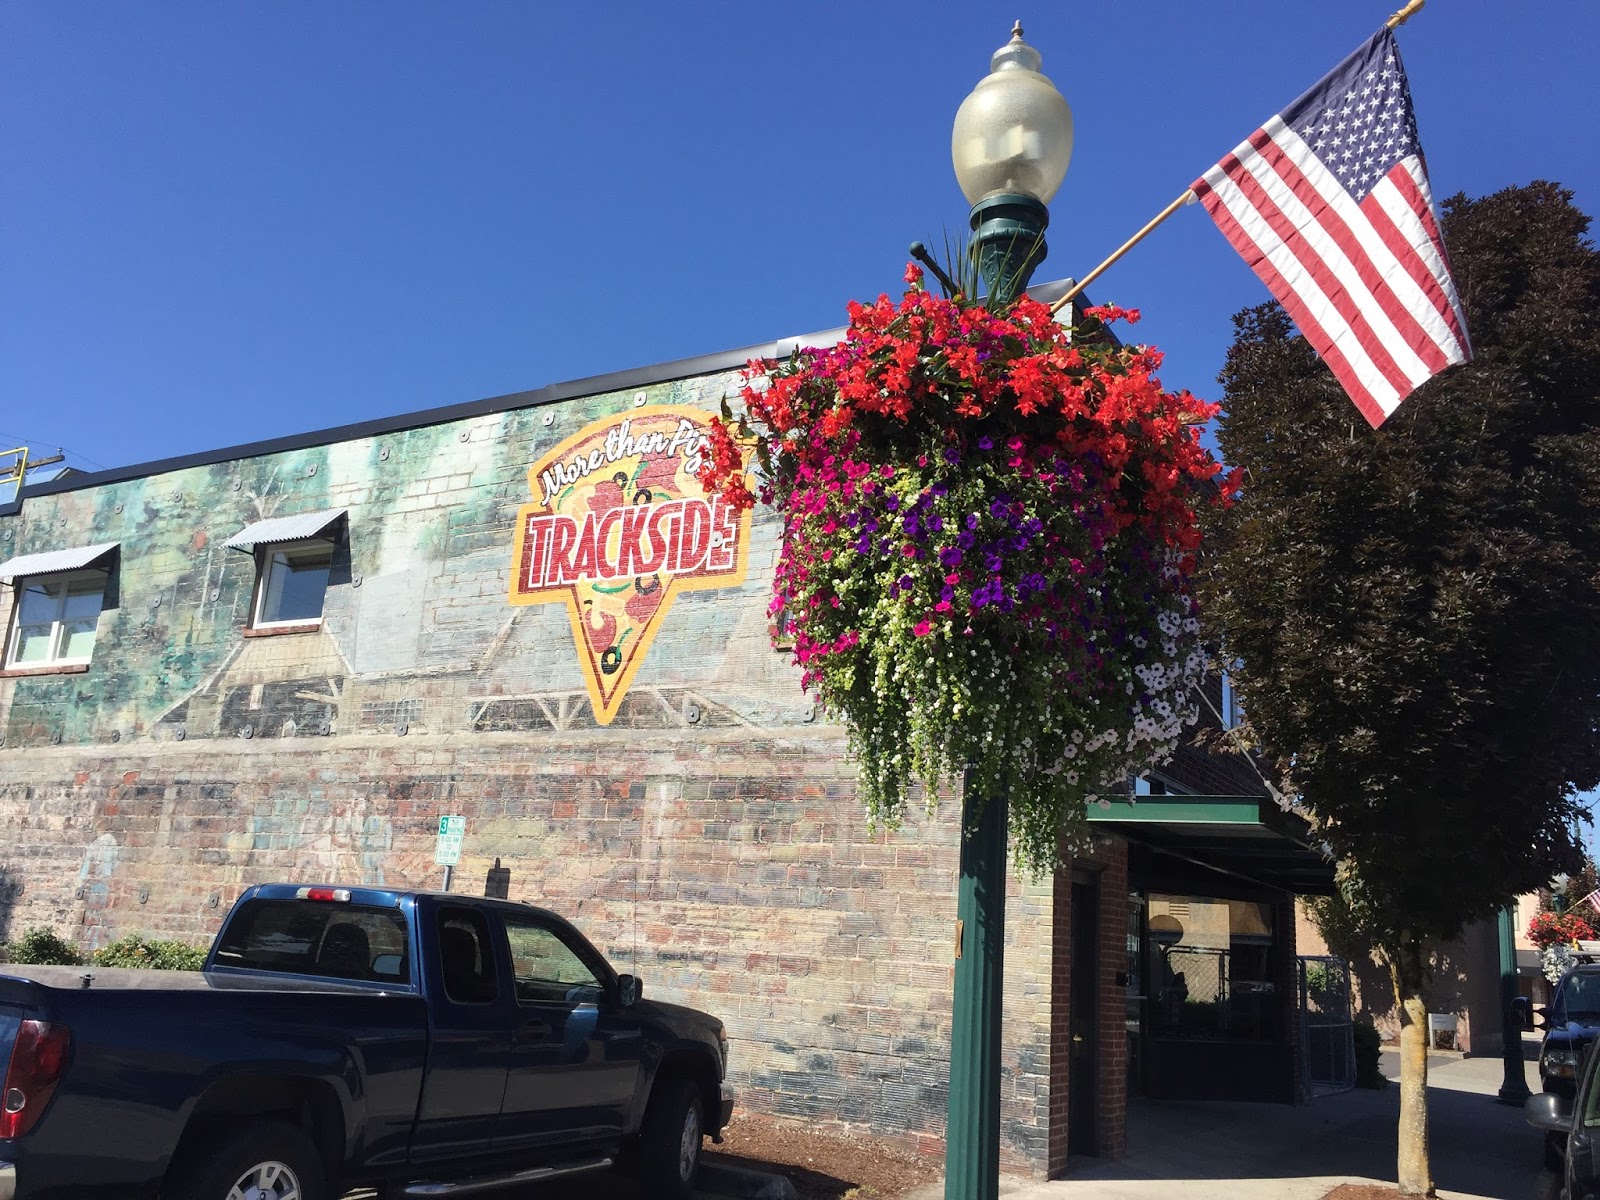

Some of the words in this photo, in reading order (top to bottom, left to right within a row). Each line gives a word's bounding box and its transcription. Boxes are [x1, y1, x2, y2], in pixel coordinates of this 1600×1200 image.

[540, 449, 604, 507] More
[604, 418, 671, 463] than
[528, 494, 738, 588] TRACKSIDE
[441, 819, 448, 832] 3
